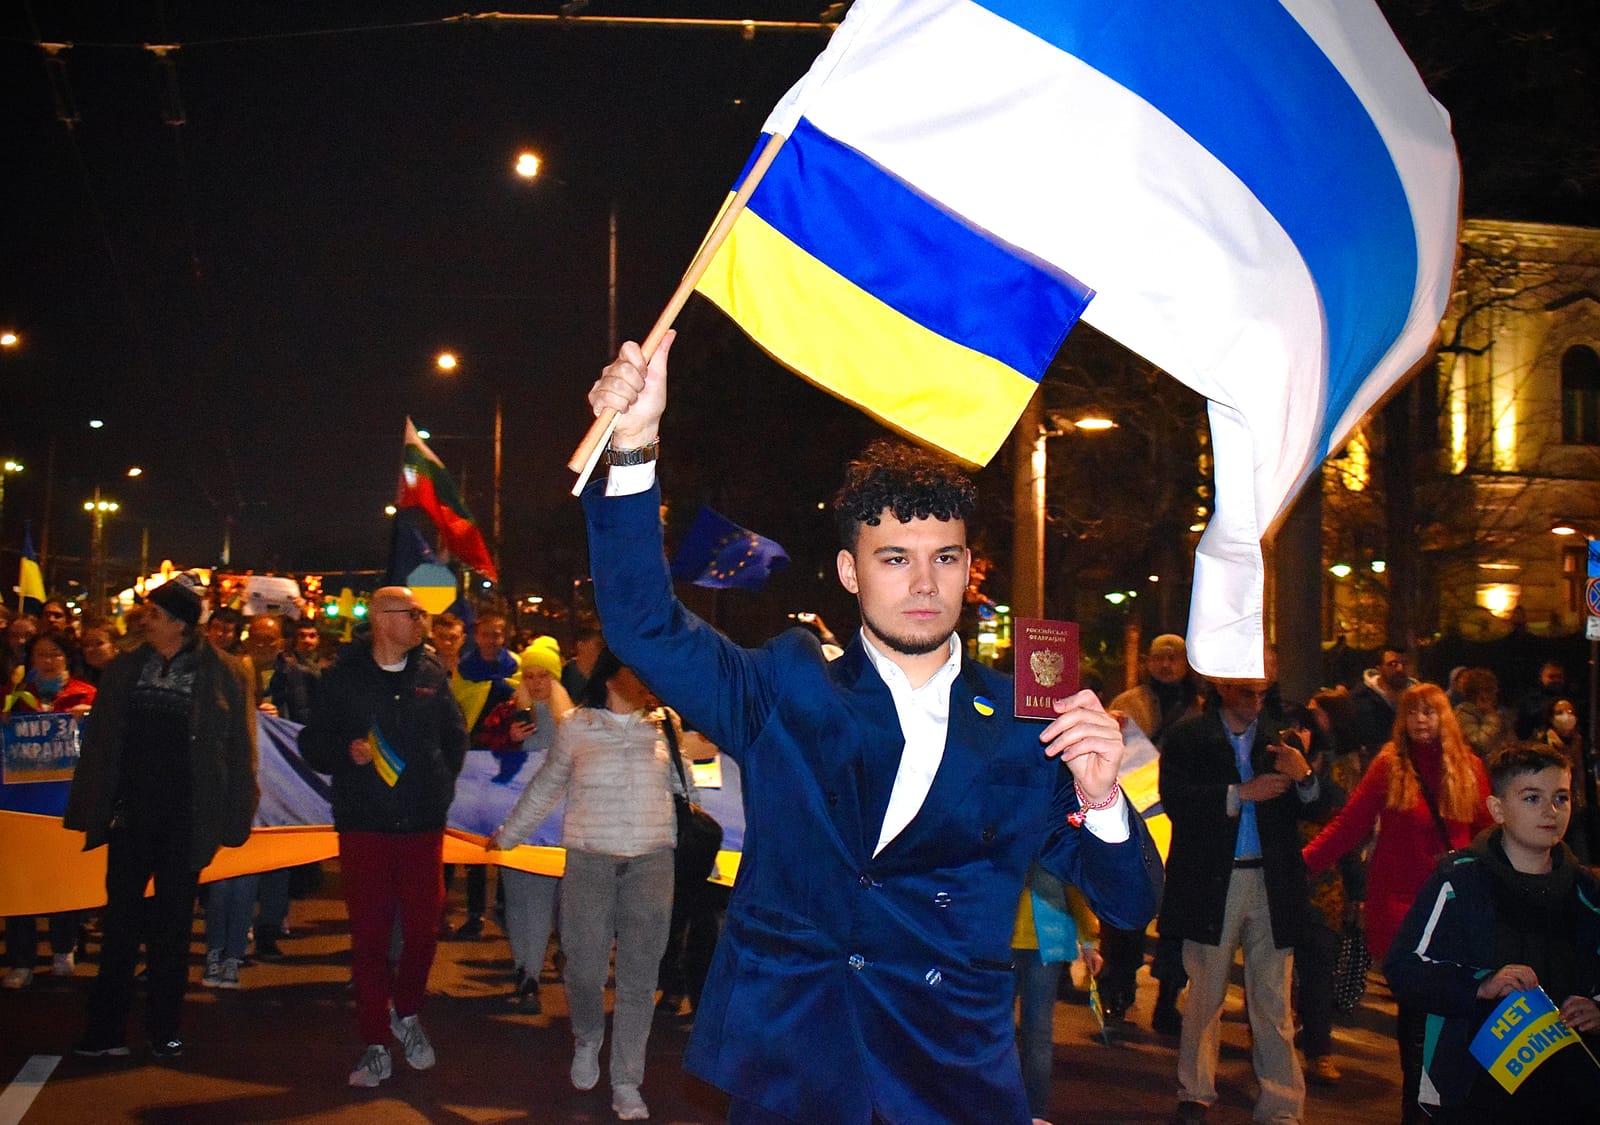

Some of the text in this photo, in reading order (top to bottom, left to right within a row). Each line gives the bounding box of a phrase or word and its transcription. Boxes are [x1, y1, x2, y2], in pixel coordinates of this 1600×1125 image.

[1026, 627, 1068, 635] РОССИЙСКАЯ
[1028, 634, 1066, 642] ФЕДЕРАЦИЯ
[1025, 695, 1056, 708] ПАСП
[15, 718, 78, 737] МИР ЗА
[1490, 996, 1532, 1040] НЕТ
[1505, 1020, 1572, 1077] ВОЙНЕ
